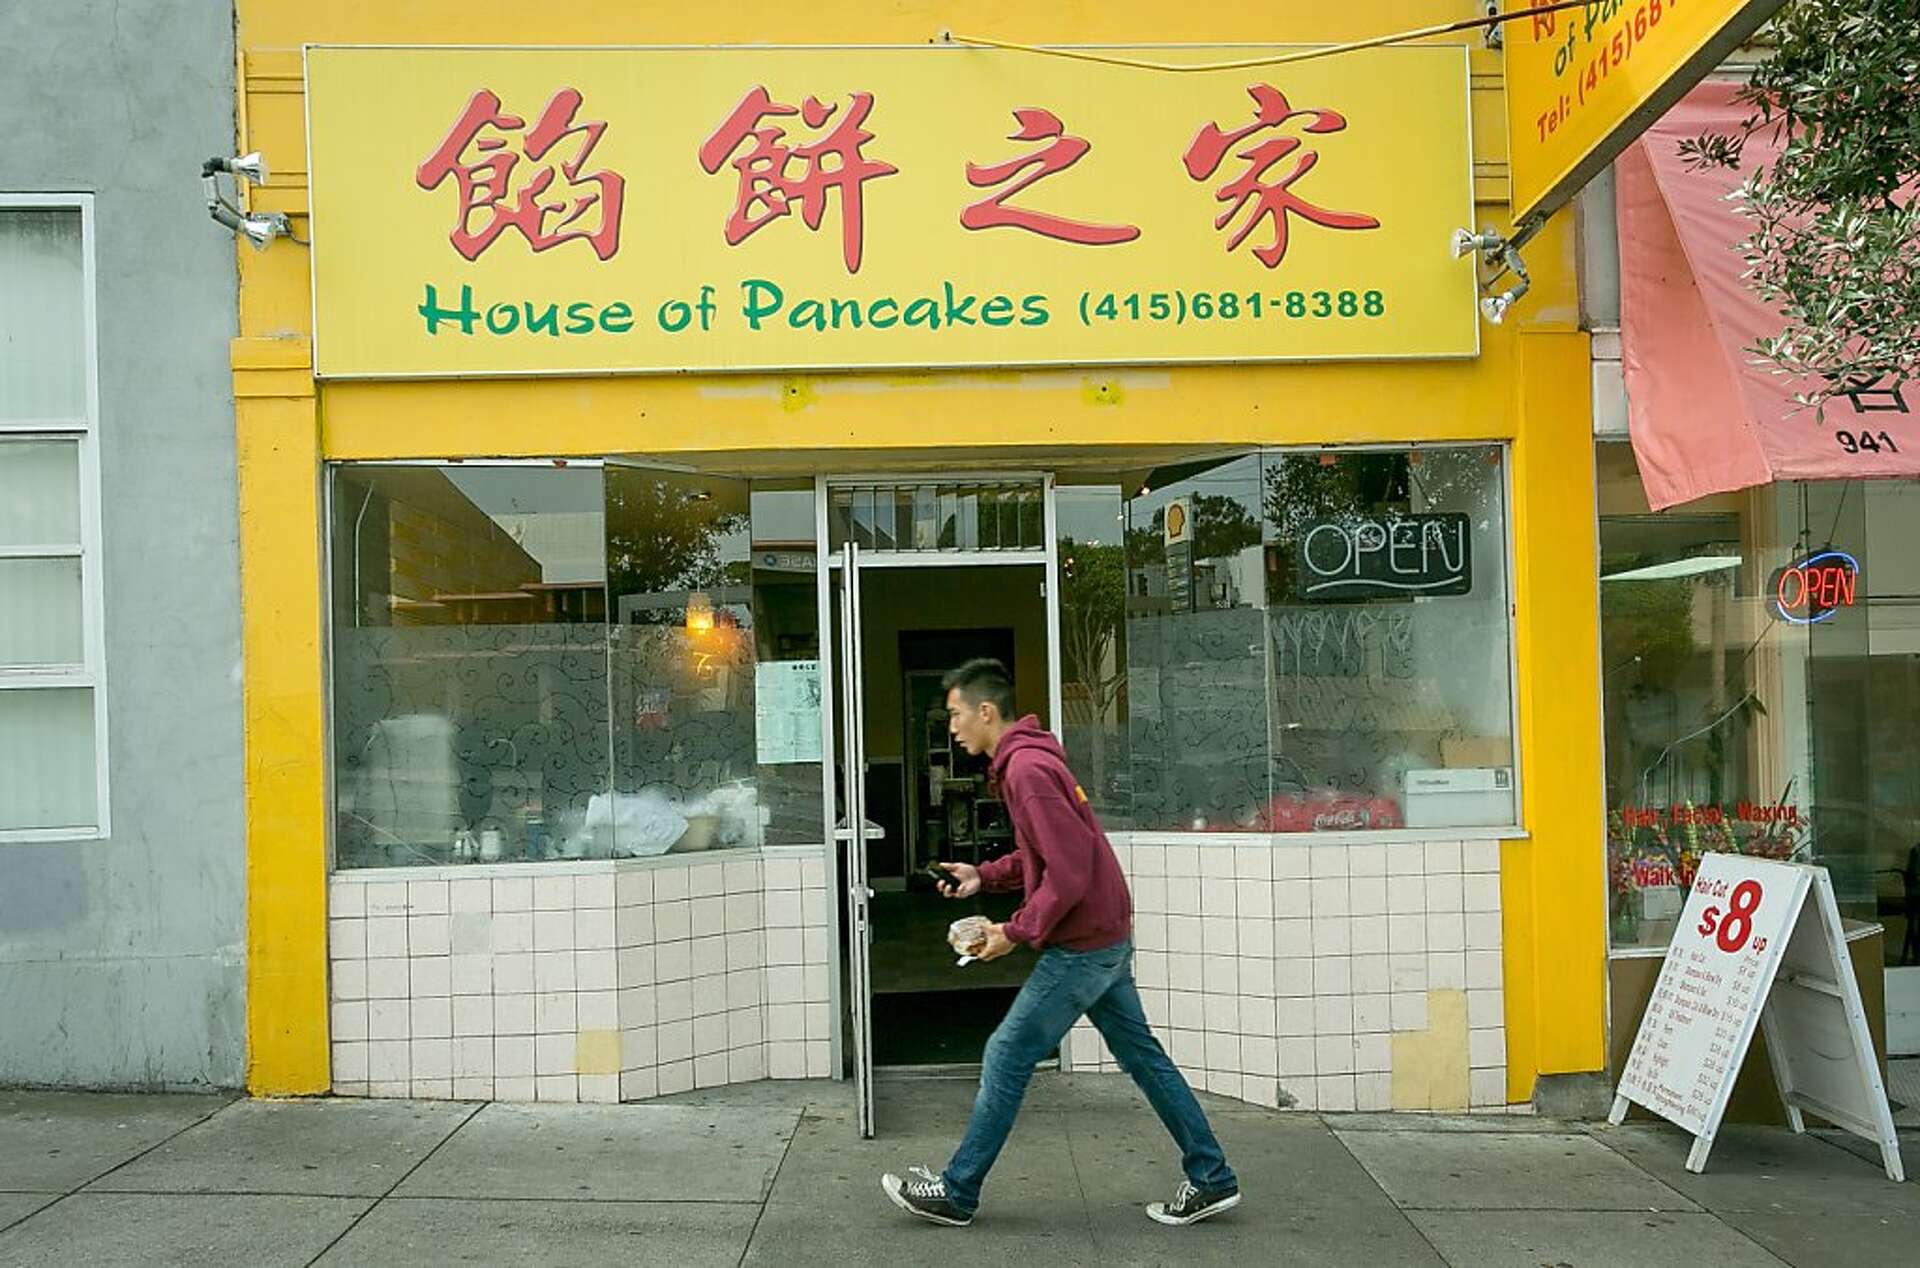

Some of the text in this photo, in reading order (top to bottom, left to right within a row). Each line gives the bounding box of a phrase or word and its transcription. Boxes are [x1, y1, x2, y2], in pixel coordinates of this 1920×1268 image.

[1537, 95, 1570, 142] Tel:
[1578, 0, 1675, 105] (415)68
[1555, 22, 1575, 76] of
[417, 84, 1380, 271] 餡餅之家
[417, 278, 1385, 338] House of Pancakes (415)681-8388
[1835, 430, 1899, 454] 941
[1303, 519, 1465, 576] OPEN
[1777, 567, 1857, 609] OPEN
[1737, 801, 1797, 825] Waxing
[1632, 859, 1675, 886] Walk
